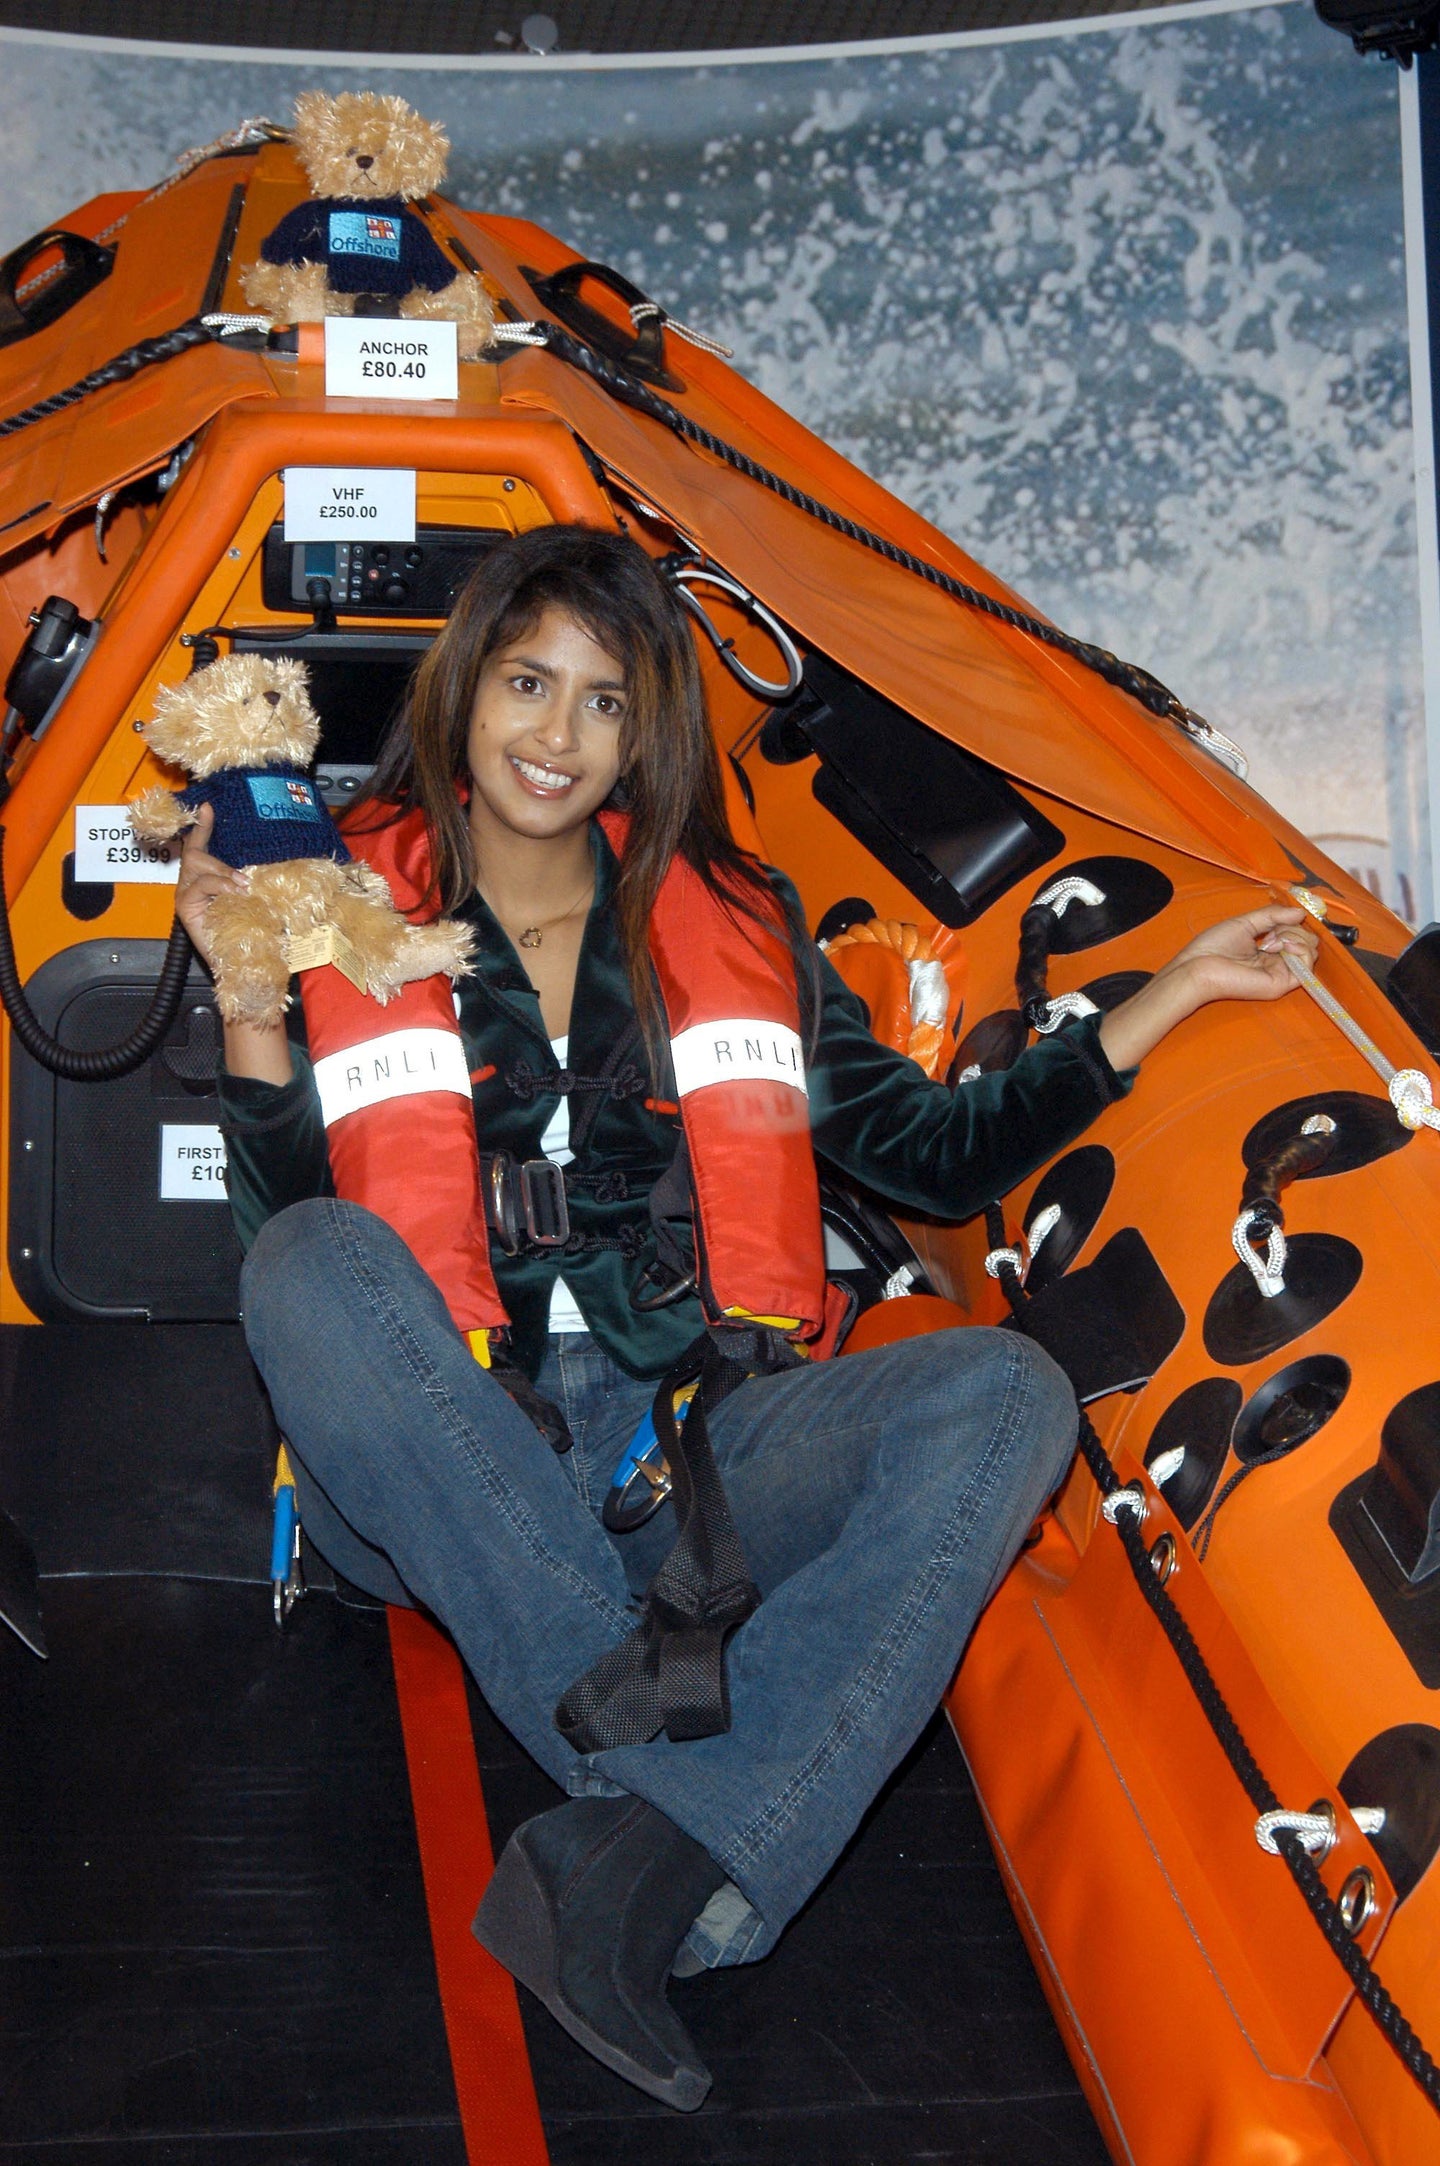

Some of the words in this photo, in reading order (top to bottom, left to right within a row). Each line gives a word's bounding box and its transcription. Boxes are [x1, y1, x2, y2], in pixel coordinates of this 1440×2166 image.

[332, 237, 398, 258] Offshore
[360, 341, 428, 356] ANCHOR
[362, 360, 426, 379] £80.40
[332, 487, 365, 501] VHF
[320, 505, 377, 519] £250.00
[106, 847, 171, 864] £39.99
[178, 1147, 222, 1159] FIRST
